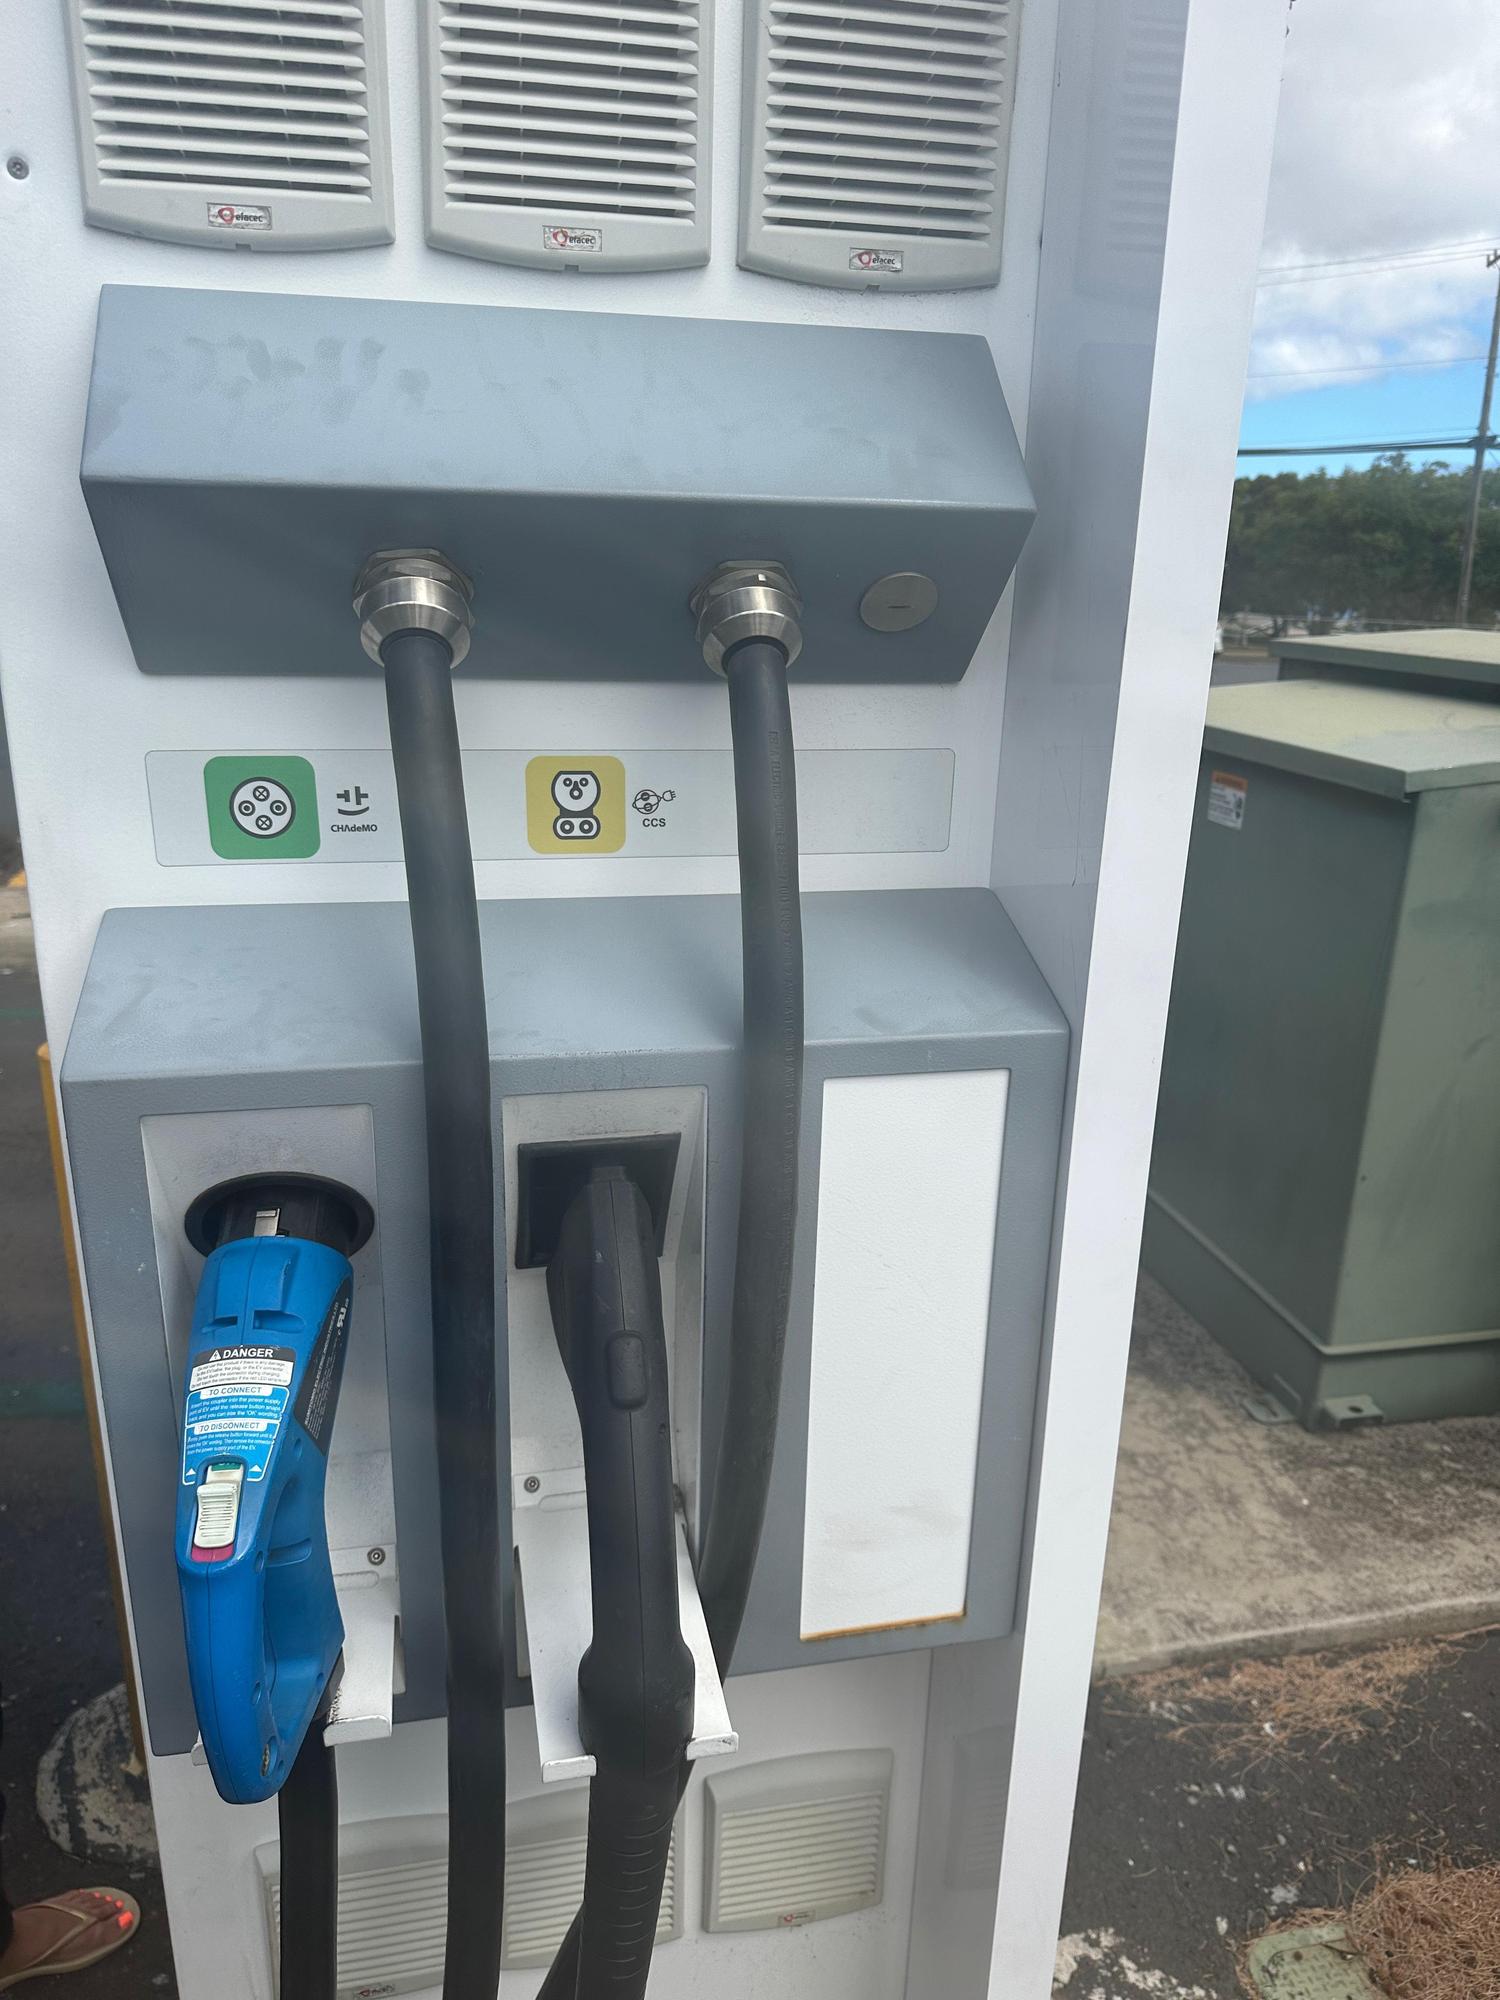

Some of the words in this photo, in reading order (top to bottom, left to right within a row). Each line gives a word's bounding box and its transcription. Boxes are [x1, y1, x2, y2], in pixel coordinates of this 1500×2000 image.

[642, 818, 666, 827] CCS
[330, 824, 378, 832] CHAdeMO
[223, 1348, 273, 1358] DANGER
[209, 1388, 220, 1396] TO
[221, 1387, 262, 1395] CONNECT
[211, 1422, 260, 1430] DISCONNECT
